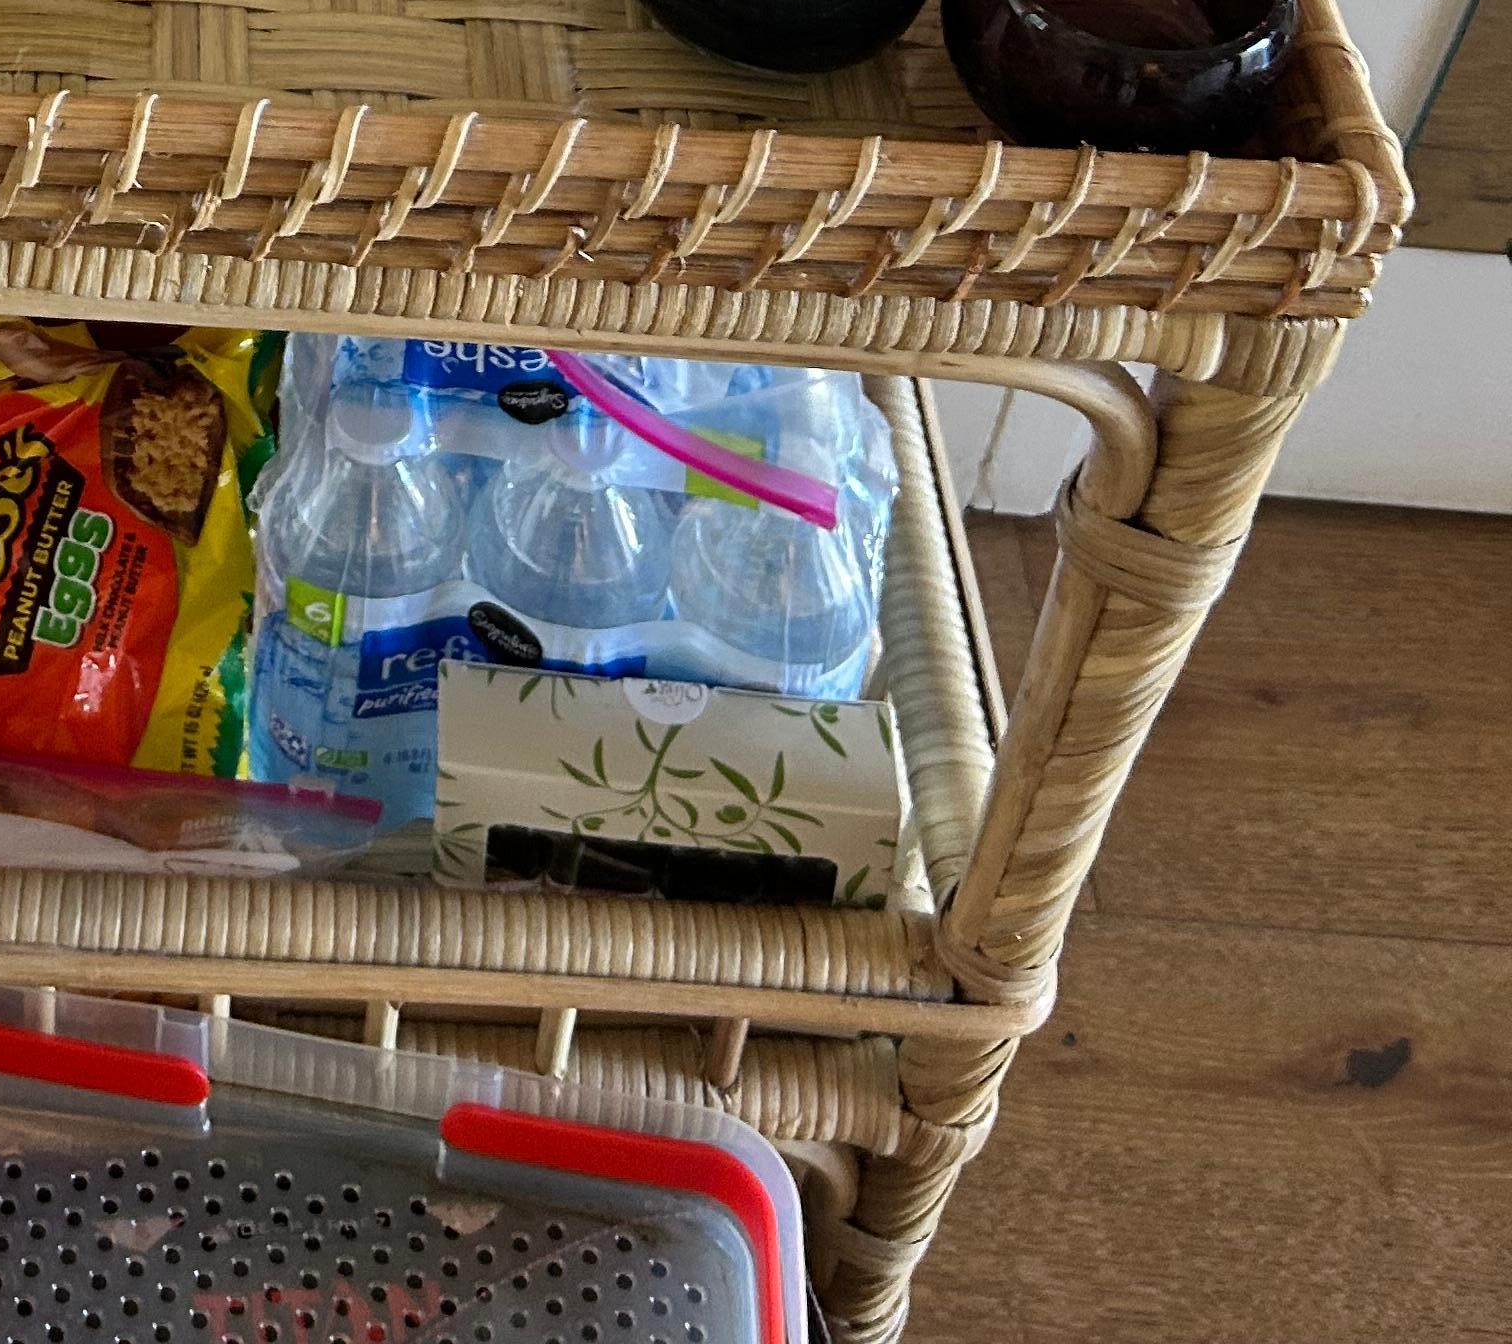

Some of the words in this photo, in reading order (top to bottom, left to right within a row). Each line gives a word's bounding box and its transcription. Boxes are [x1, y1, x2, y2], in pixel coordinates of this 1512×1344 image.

[2, 564, 44, 662] PEANUT
[31, 478, 76, 566] BUTTER
[193, 1278, 444, 1344] TITAN
